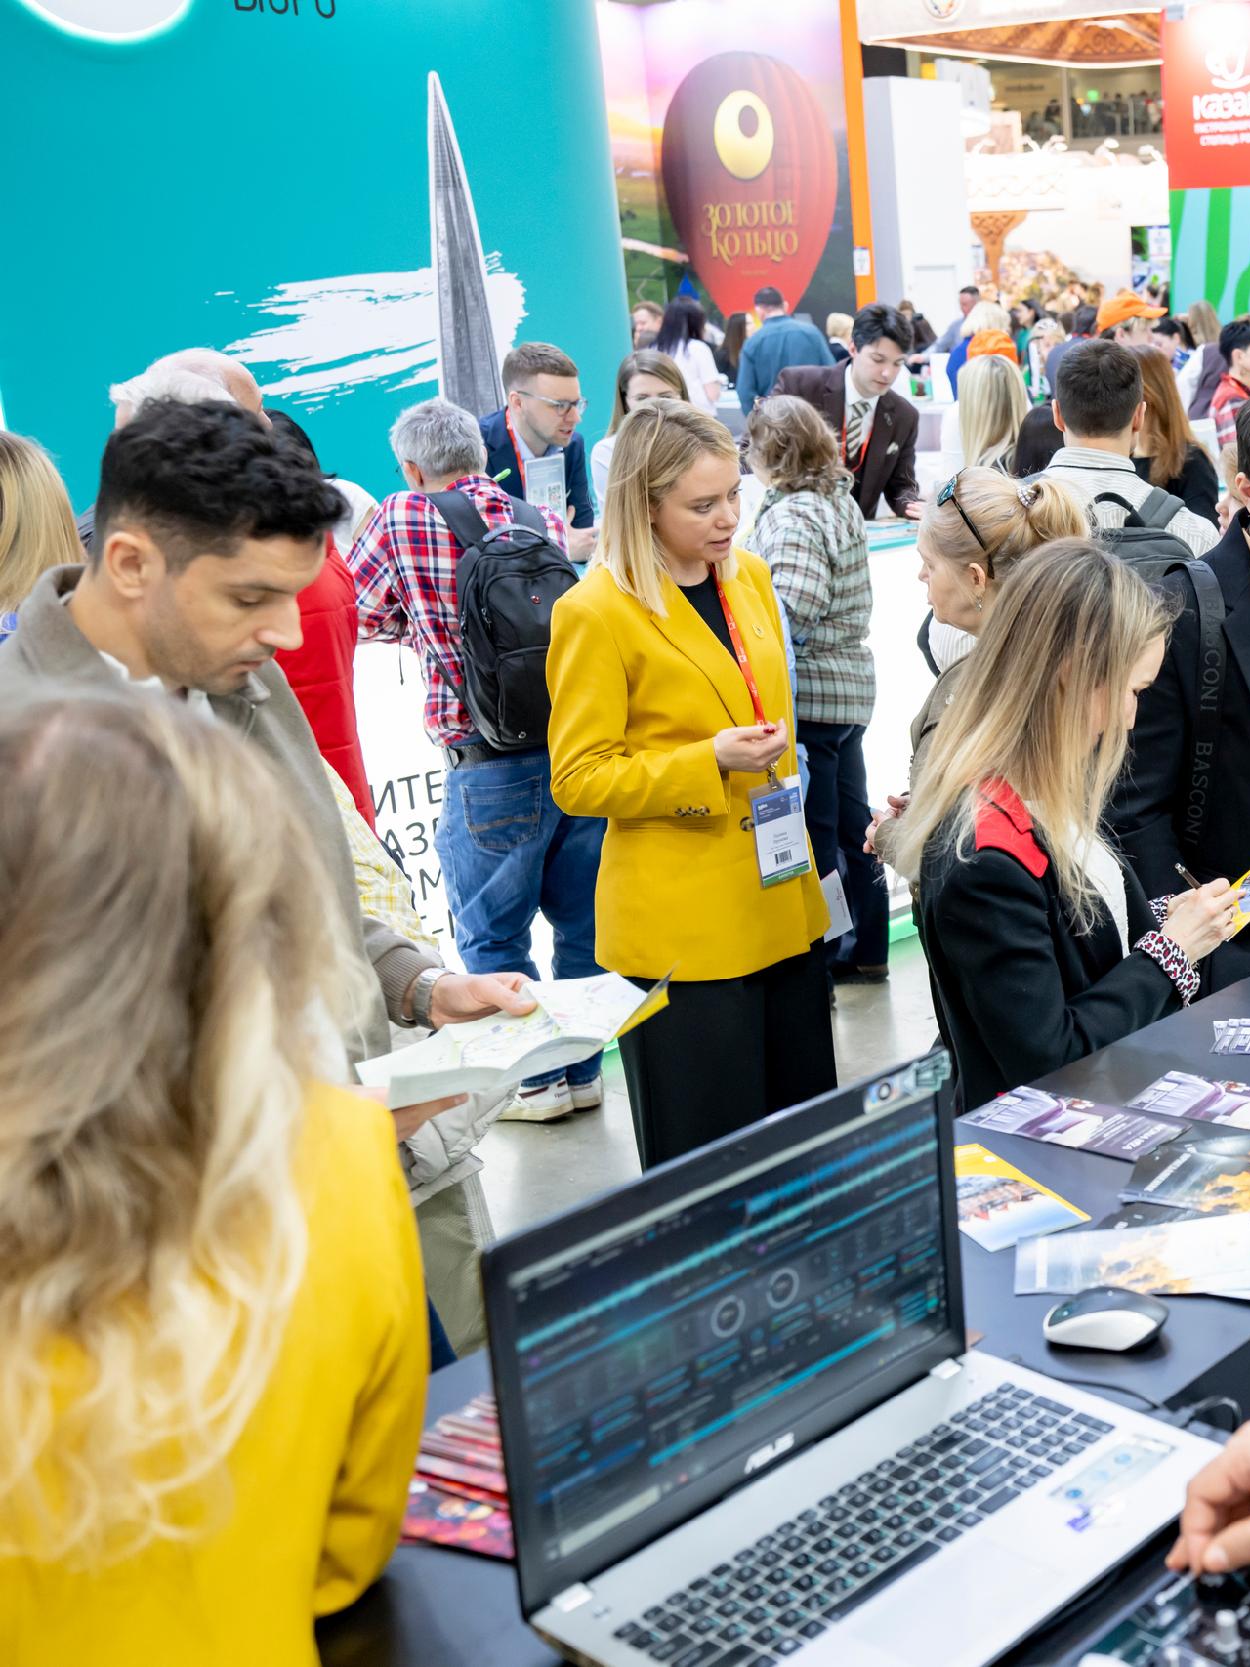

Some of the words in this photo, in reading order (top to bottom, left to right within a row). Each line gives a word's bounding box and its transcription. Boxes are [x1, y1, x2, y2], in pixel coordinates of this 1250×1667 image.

[1184, 740, 1214, 846] BASCONI
[384, 815, 441, 860] АЗ
[744, 1431, 795, 1475] ASUS
